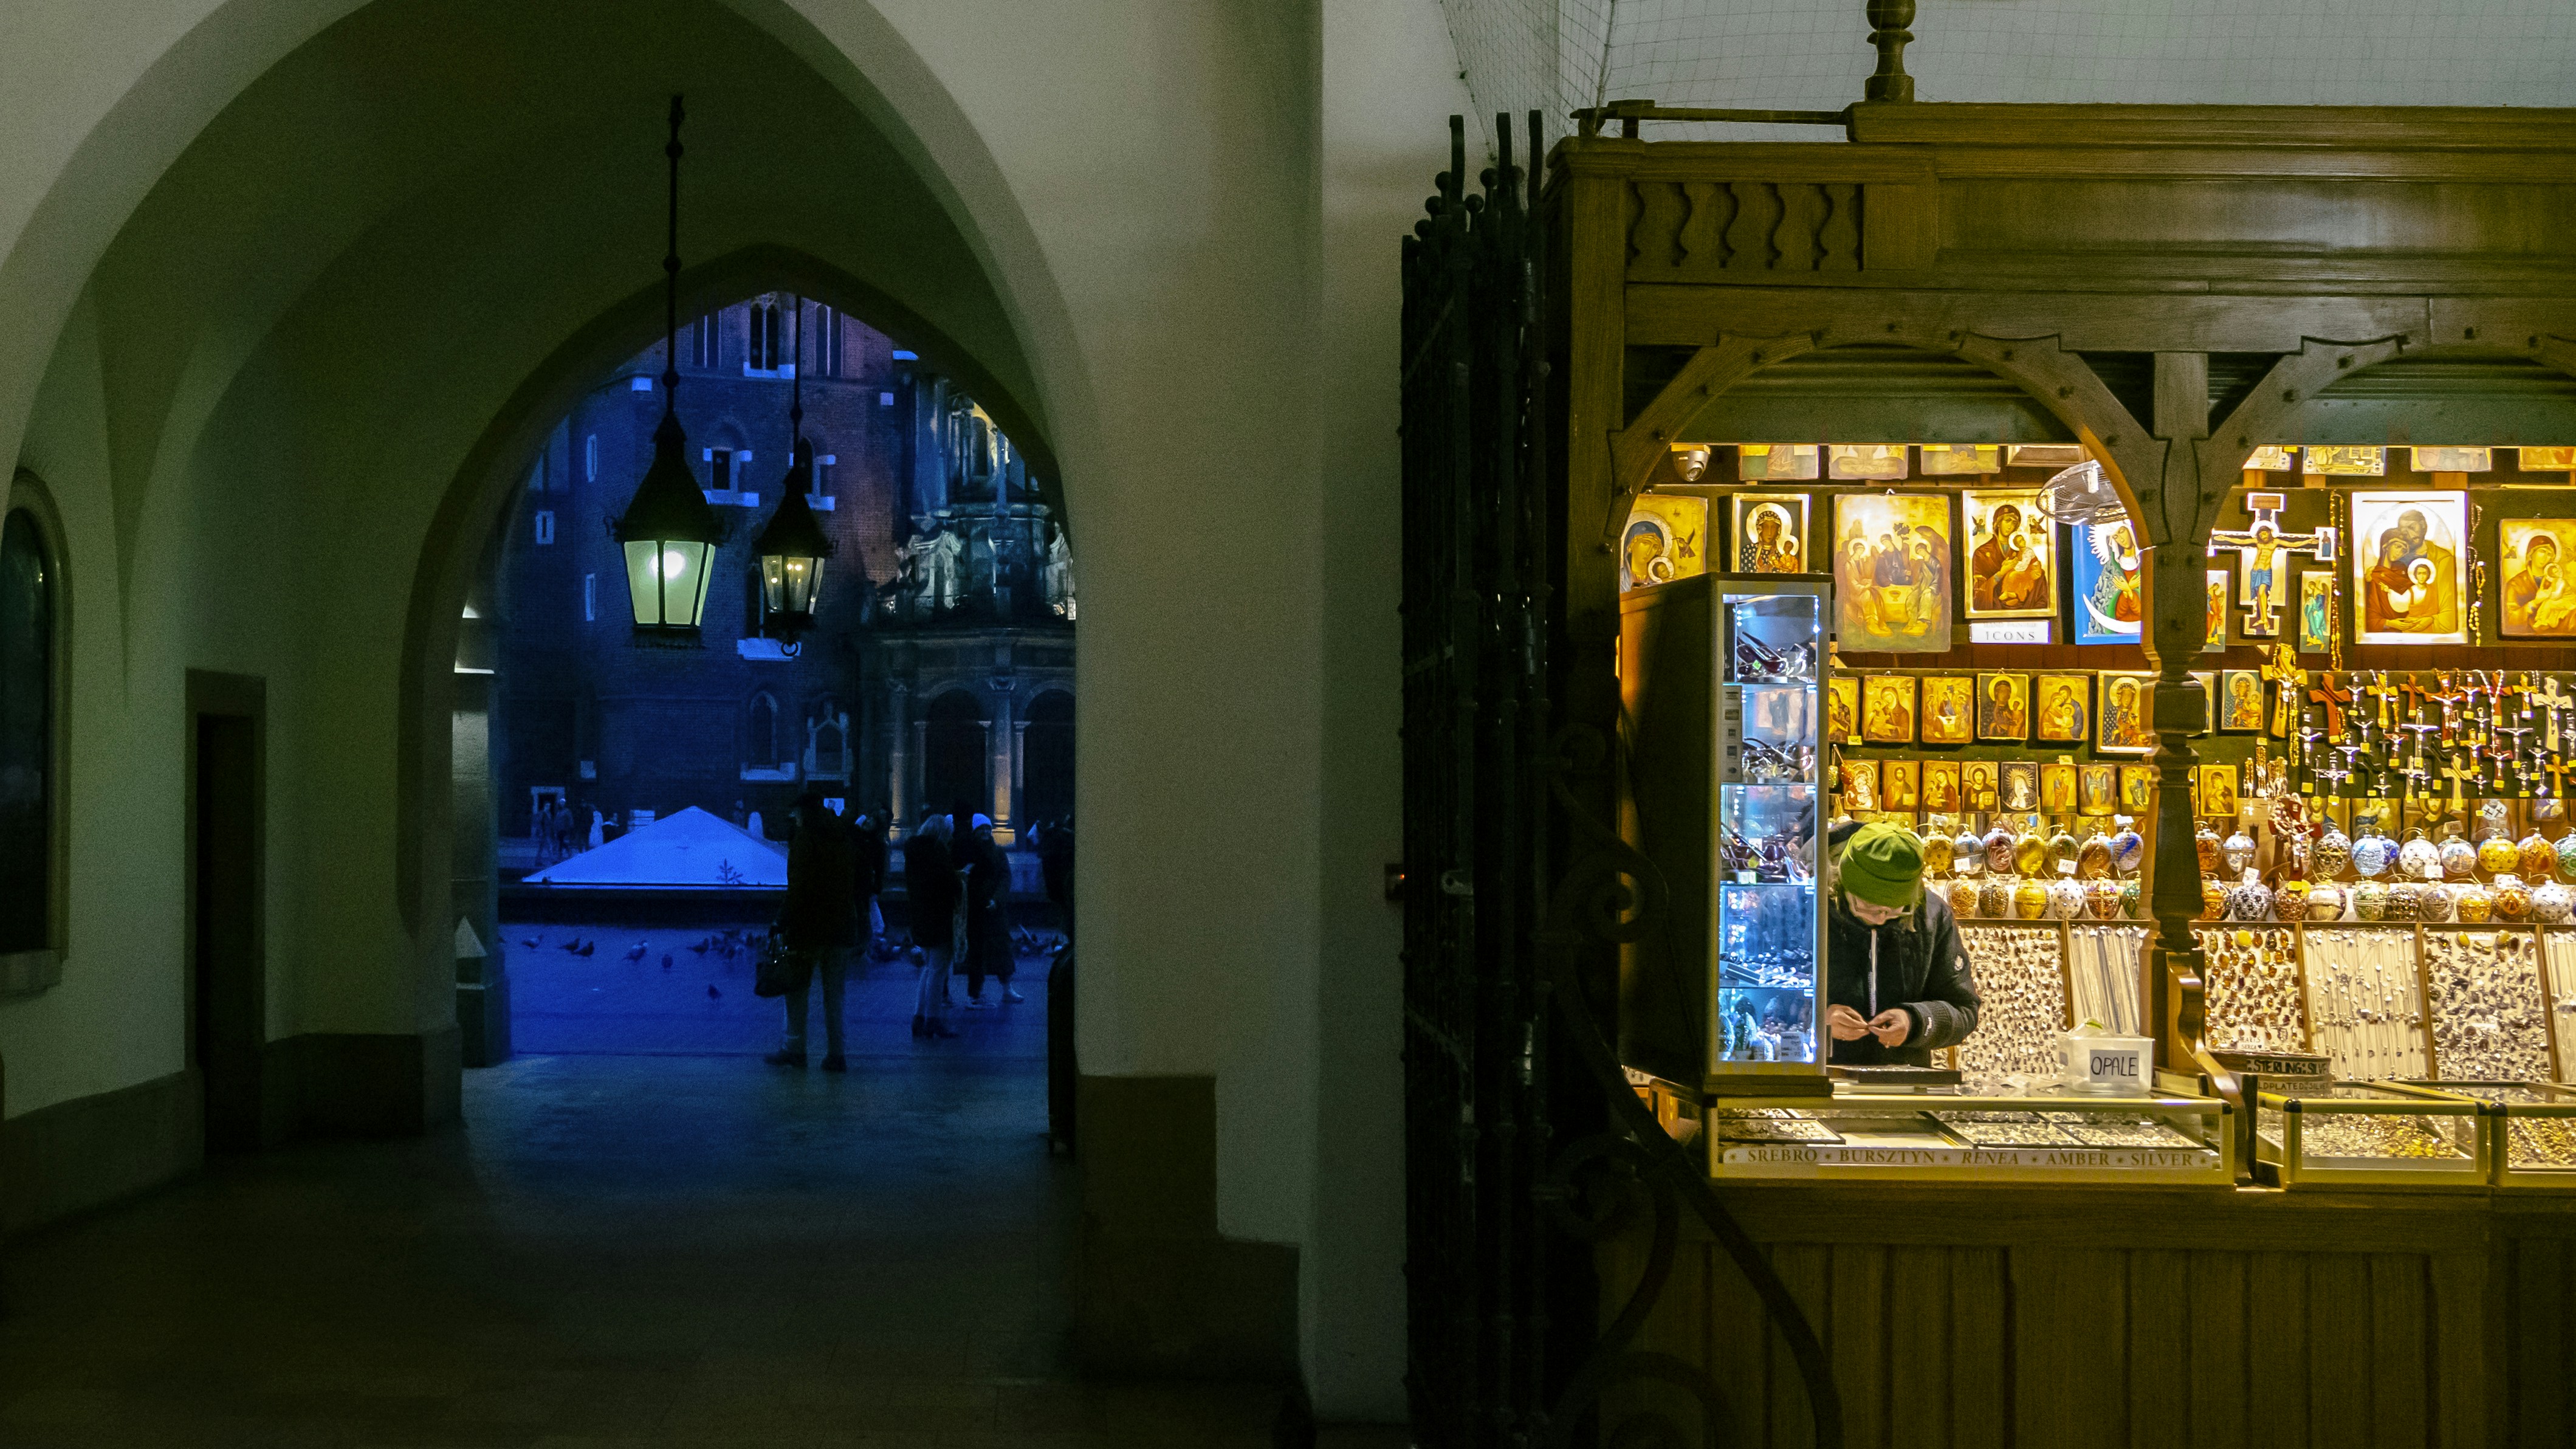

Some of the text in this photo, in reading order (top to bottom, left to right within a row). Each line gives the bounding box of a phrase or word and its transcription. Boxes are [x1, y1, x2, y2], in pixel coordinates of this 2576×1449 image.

[1986, 631, 2035, 641] ICONS
[2091, 1056, 2137, 1076] OPALE
[1748, 1149, 2193, 1166] SREBRO BURSZTYN RENEA AMBER SILVER
